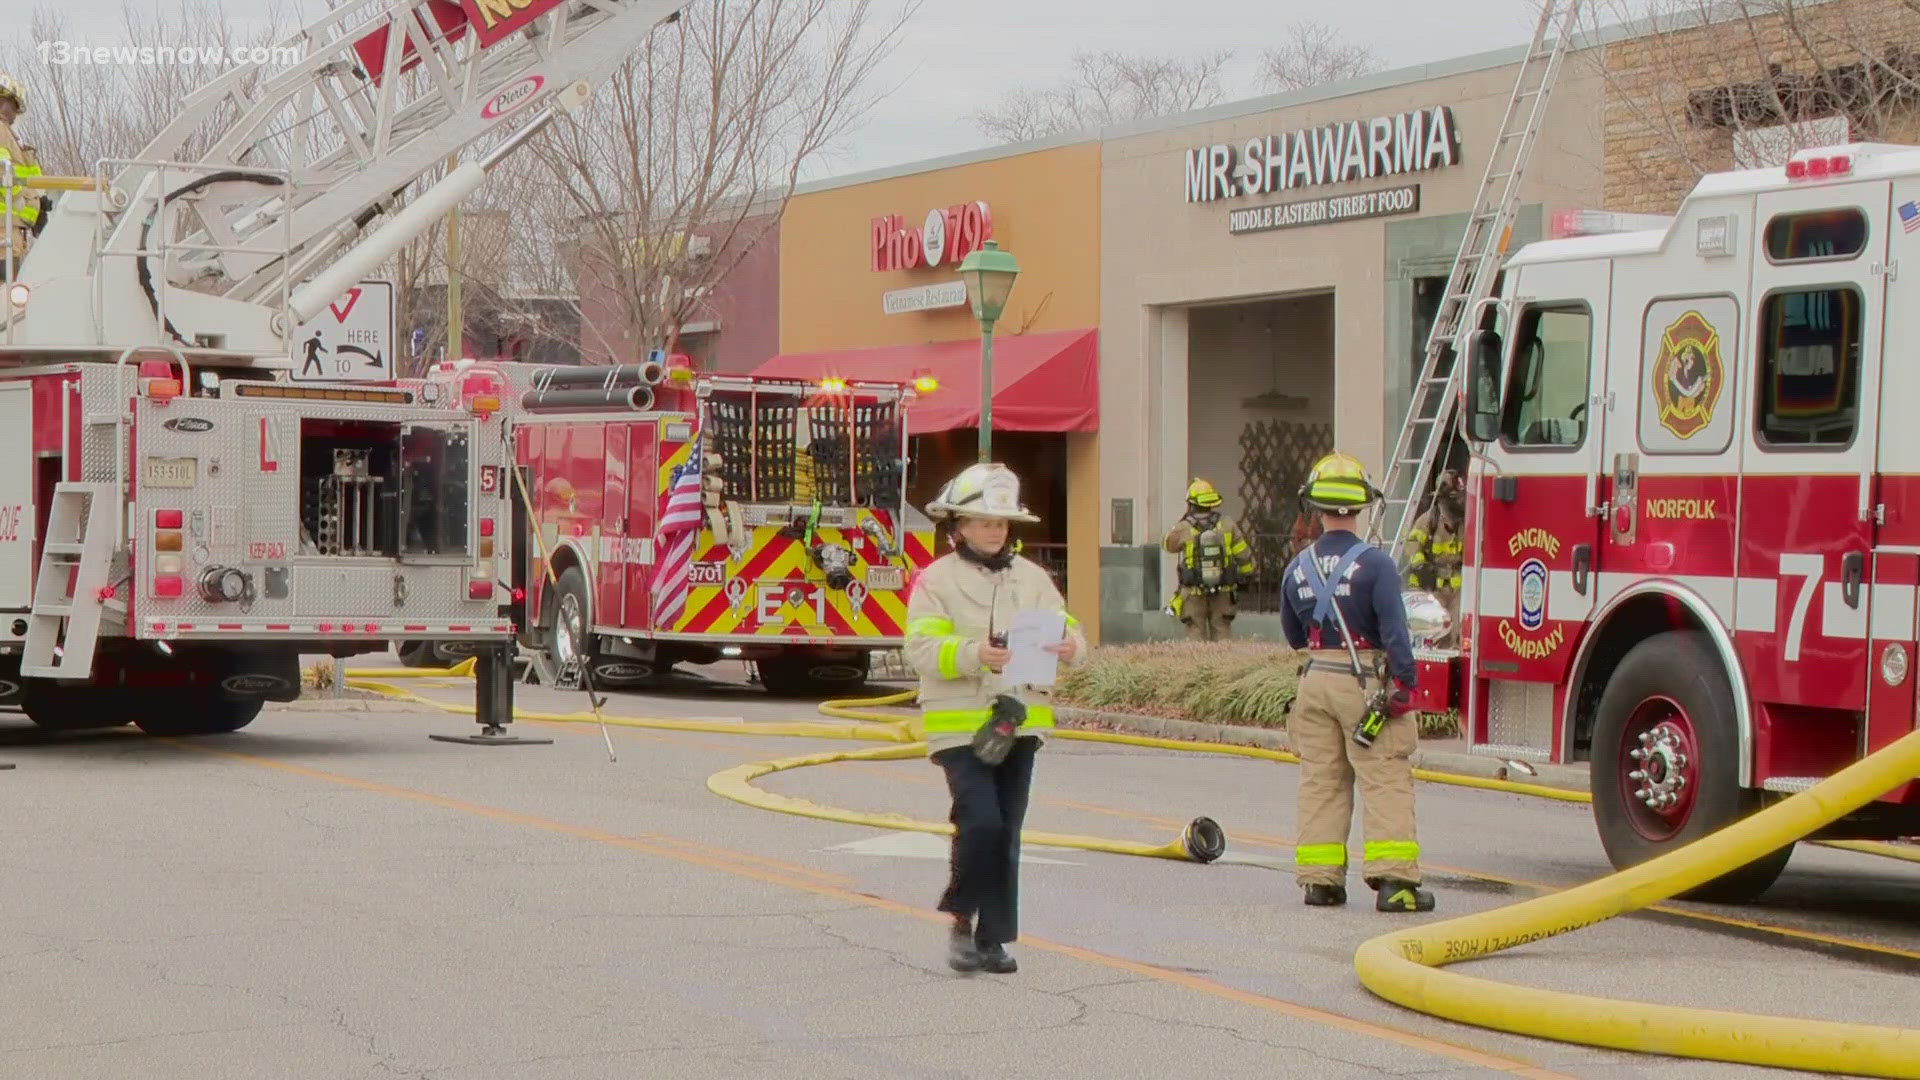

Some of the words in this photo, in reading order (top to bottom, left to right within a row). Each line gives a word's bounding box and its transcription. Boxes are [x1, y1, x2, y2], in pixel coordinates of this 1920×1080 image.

[495, 83, 532, 112] Pierce
[1184, 143, 1237, 203] MR.
[1242, 104, 1452, 195] SHAWARMA
[1230, 209, 1272, 232] MIDDLE
[1274, 199, 1327, 226] EASTERN
[1329, 193, 1377, 219] STREET
[1378, 187, 1414, 212] FOOD
[870, 213, 921, 272] Pho
[947, 200, 985, 262] 79
[347, 329, 379, 343] HERE
[335, 359, 351, 373] TO
[483, 468, 494, 490] 5
[1646, 498, 1716, 520] NORFOLK
[1508, 527, 1560, 560] ENGINE
[688, 564, 722, 583] 9701
[756, 586, 784, 625] E
[807, 587, 826, 625] 1
[1778, 552, 1825, 662] 7
[1498, 618, 1564, 660] COMPANY
[1444, 940, 1481, 959] HOSE
